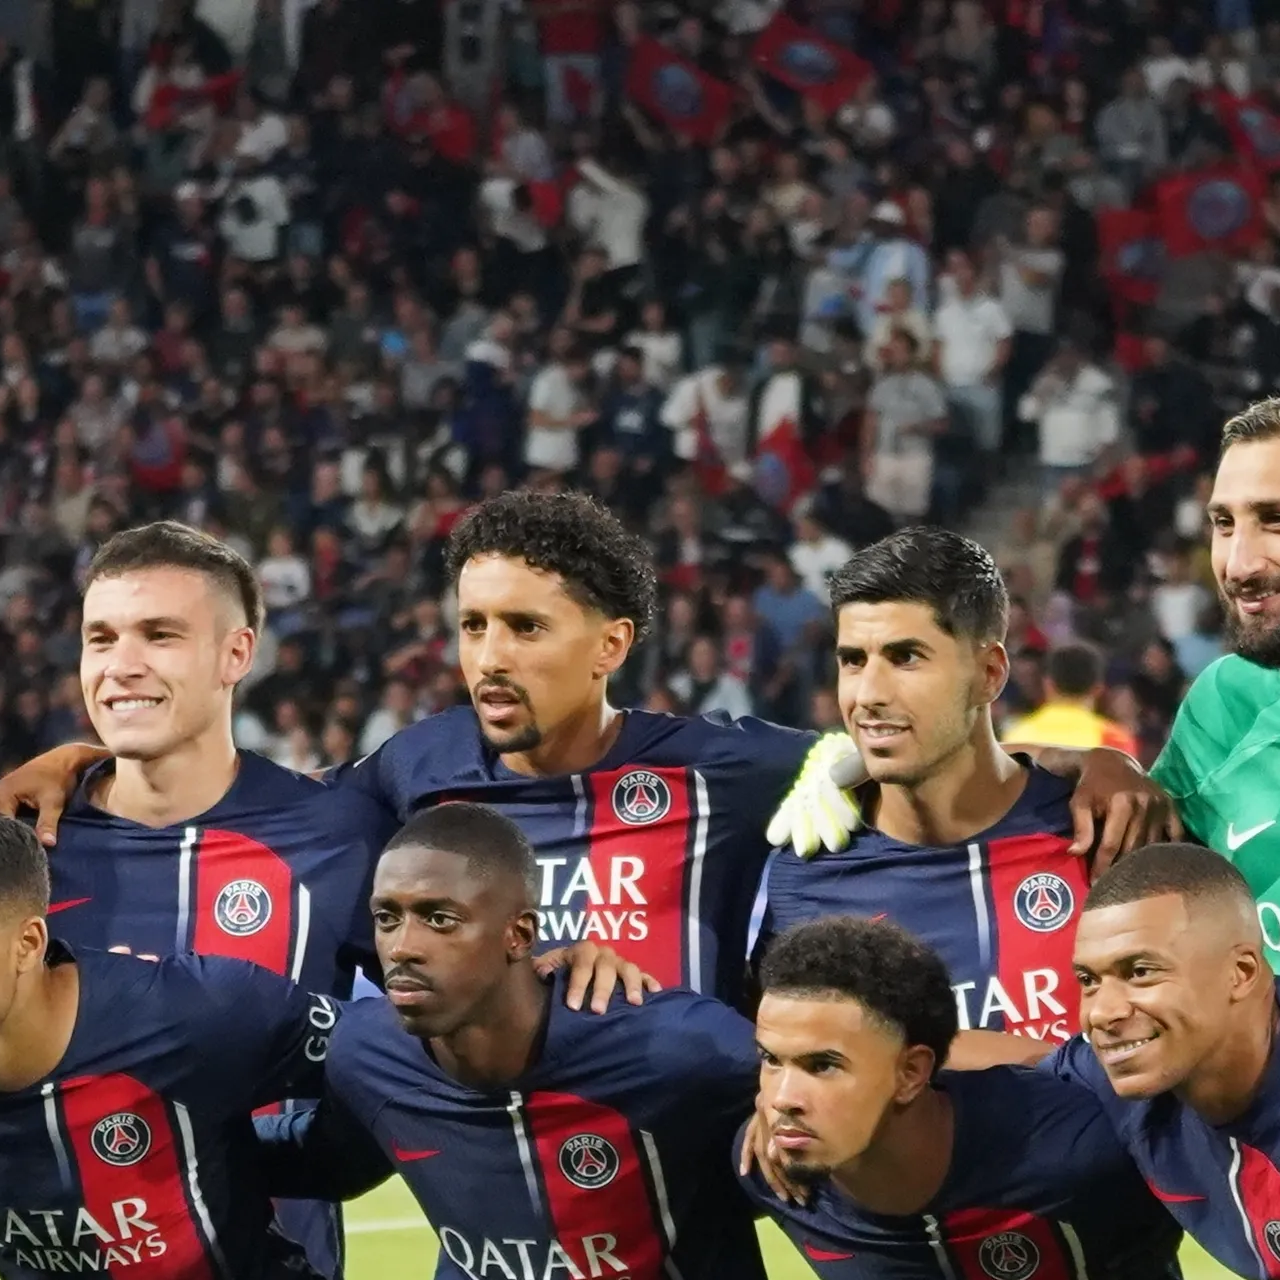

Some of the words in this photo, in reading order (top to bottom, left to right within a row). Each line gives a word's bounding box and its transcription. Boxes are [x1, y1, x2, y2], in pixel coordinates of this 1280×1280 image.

[621, 772, 658, 788] PARIS
[224, 882, 262, 898] PARIS
[535, 856, 648, 906] TAR
[1023, 875, 1061, 893] PARIS
[538, 910, 648, 942] RWAYS
[950, 968, 1068, 1031] TAR
[98, 1114, 135, 1133] PARIS
[565, 1136, 604, 1152] PARIS
[14, 1231, 168, 1273] AIRWAYS
